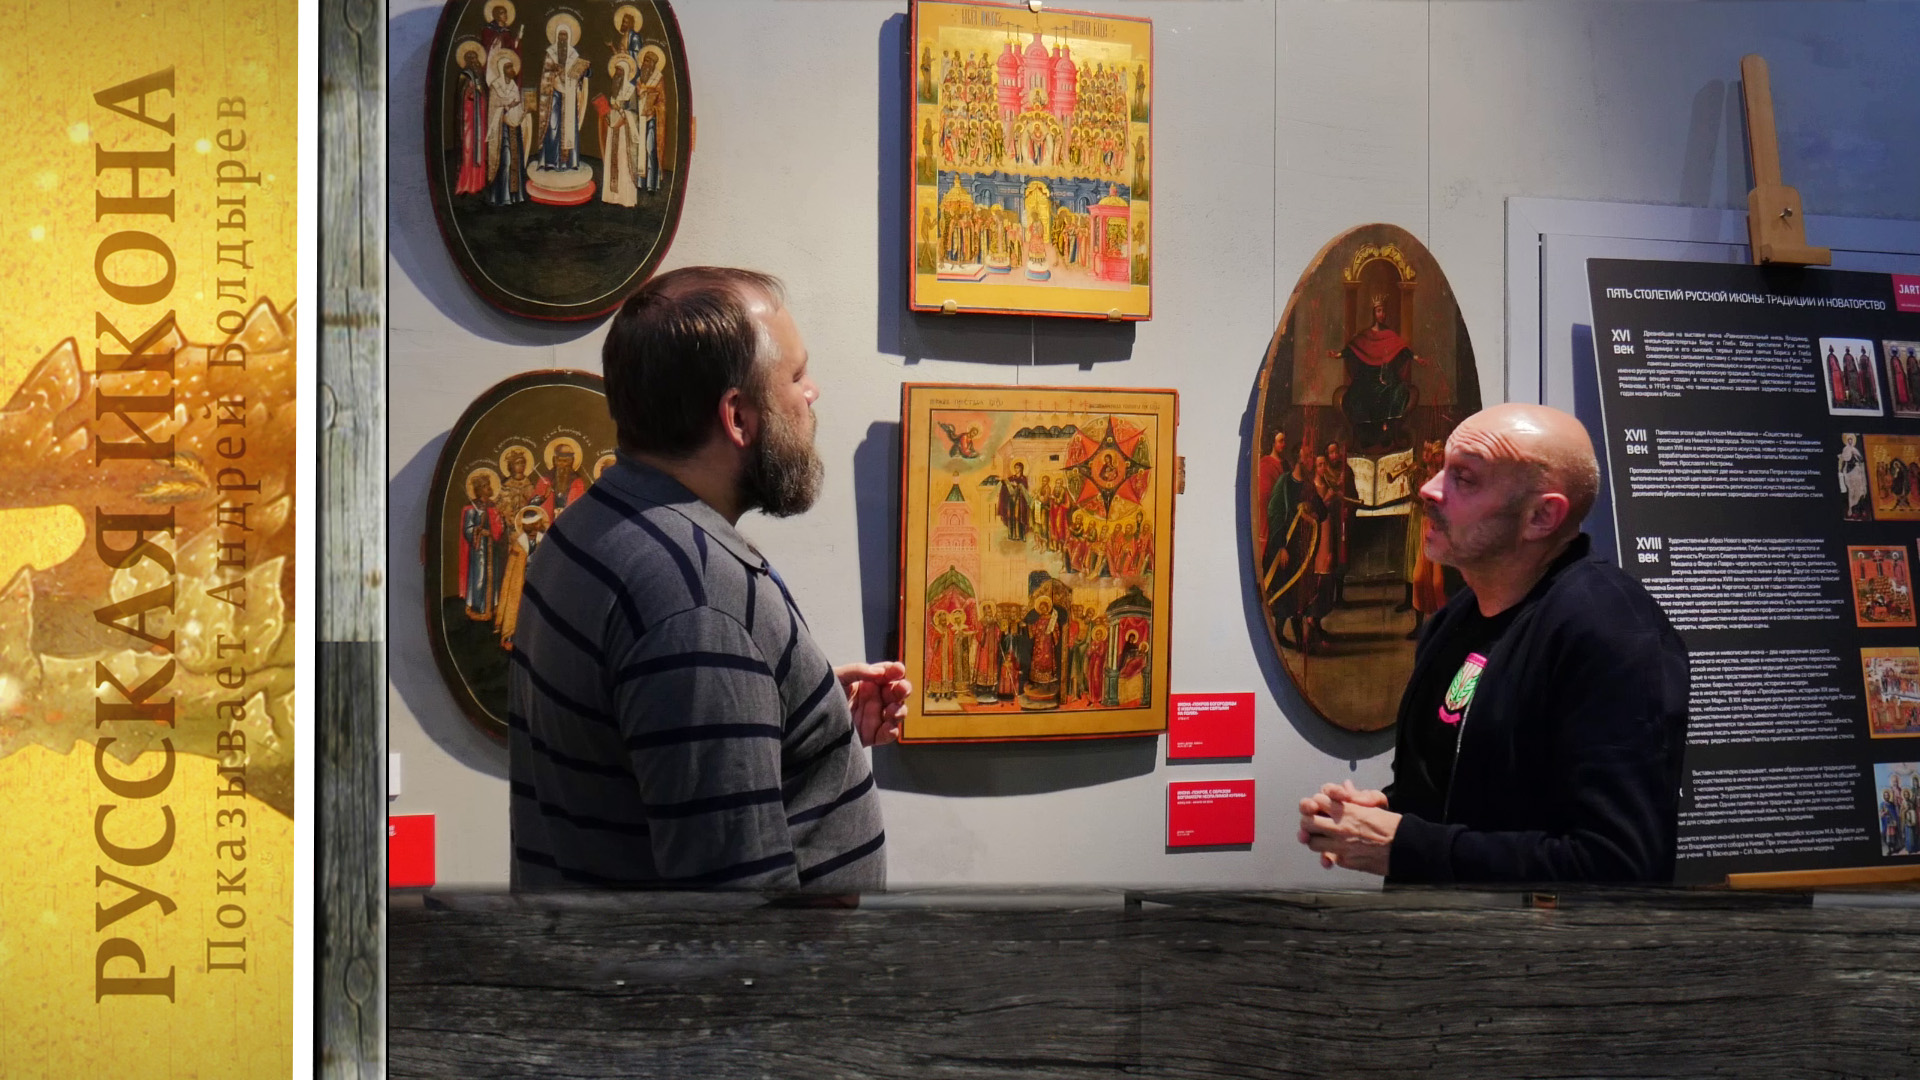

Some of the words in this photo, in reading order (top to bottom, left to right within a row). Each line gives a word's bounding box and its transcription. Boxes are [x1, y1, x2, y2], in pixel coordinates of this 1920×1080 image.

[1606, 288, 1632, 299] ПЯТЬ
[1634, 288, 1684, 300] СТОЛЕТИЙ
[1685, 290, 1728, 302] РУССКОЙ
[1766, 294, 1816, 307] ТРАДИЦИИ
[1818, 297, 1824, 307] И
[1826, 298, 1886, 310] НОВАТОРСТВО
[1611, 329, 1630, 342] XVI
[1613, 345, 1634, 354] век
[1624, 429, 1647, 442] XVII
[1626, 445, 1648, 454] век
[1636, 537, 1662, 550] XVIII
[1638, 553, 1659, 563] век
